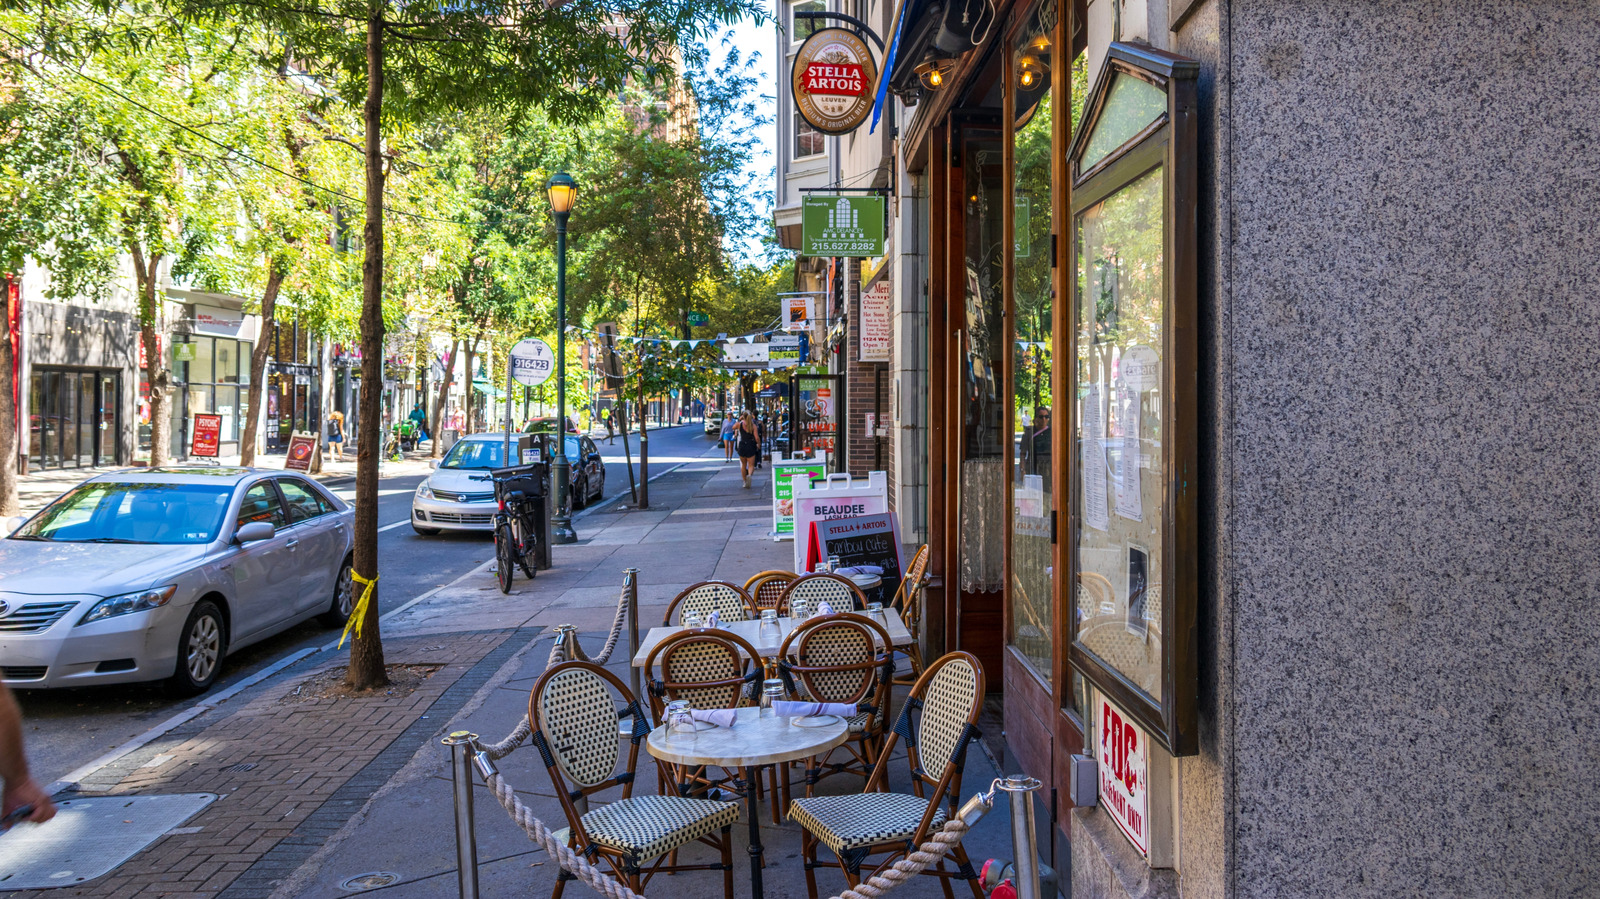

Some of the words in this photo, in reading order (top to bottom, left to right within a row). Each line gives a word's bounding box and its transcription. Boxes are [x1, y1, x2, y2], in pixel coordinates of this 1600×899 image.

[834, 34, 855, 45] LAGER
[855, 43, 868, 61] BEER
[808, 66, 861, 79] STELLA
[808, 78, 862, 91] ARTOIS
[827, 114, 857, 128] ORIGINAL
[854, 100, 867, 116] BEER
[811, 242, 875, 250] 215.627.8282
[514, 358, 548, 370] 916423
[198, 418, 218, 428] PSYCHIC
[533, 434, 541, 443] A
[814, 504, 865, 515] BEAUDEE
[829, 524, 855, 535] STELLA
[862, 520, 887, 530] ARTOIS
[827, 538, 863, 555] Caribou
[1128, 803, 1142, 838] ONLY
